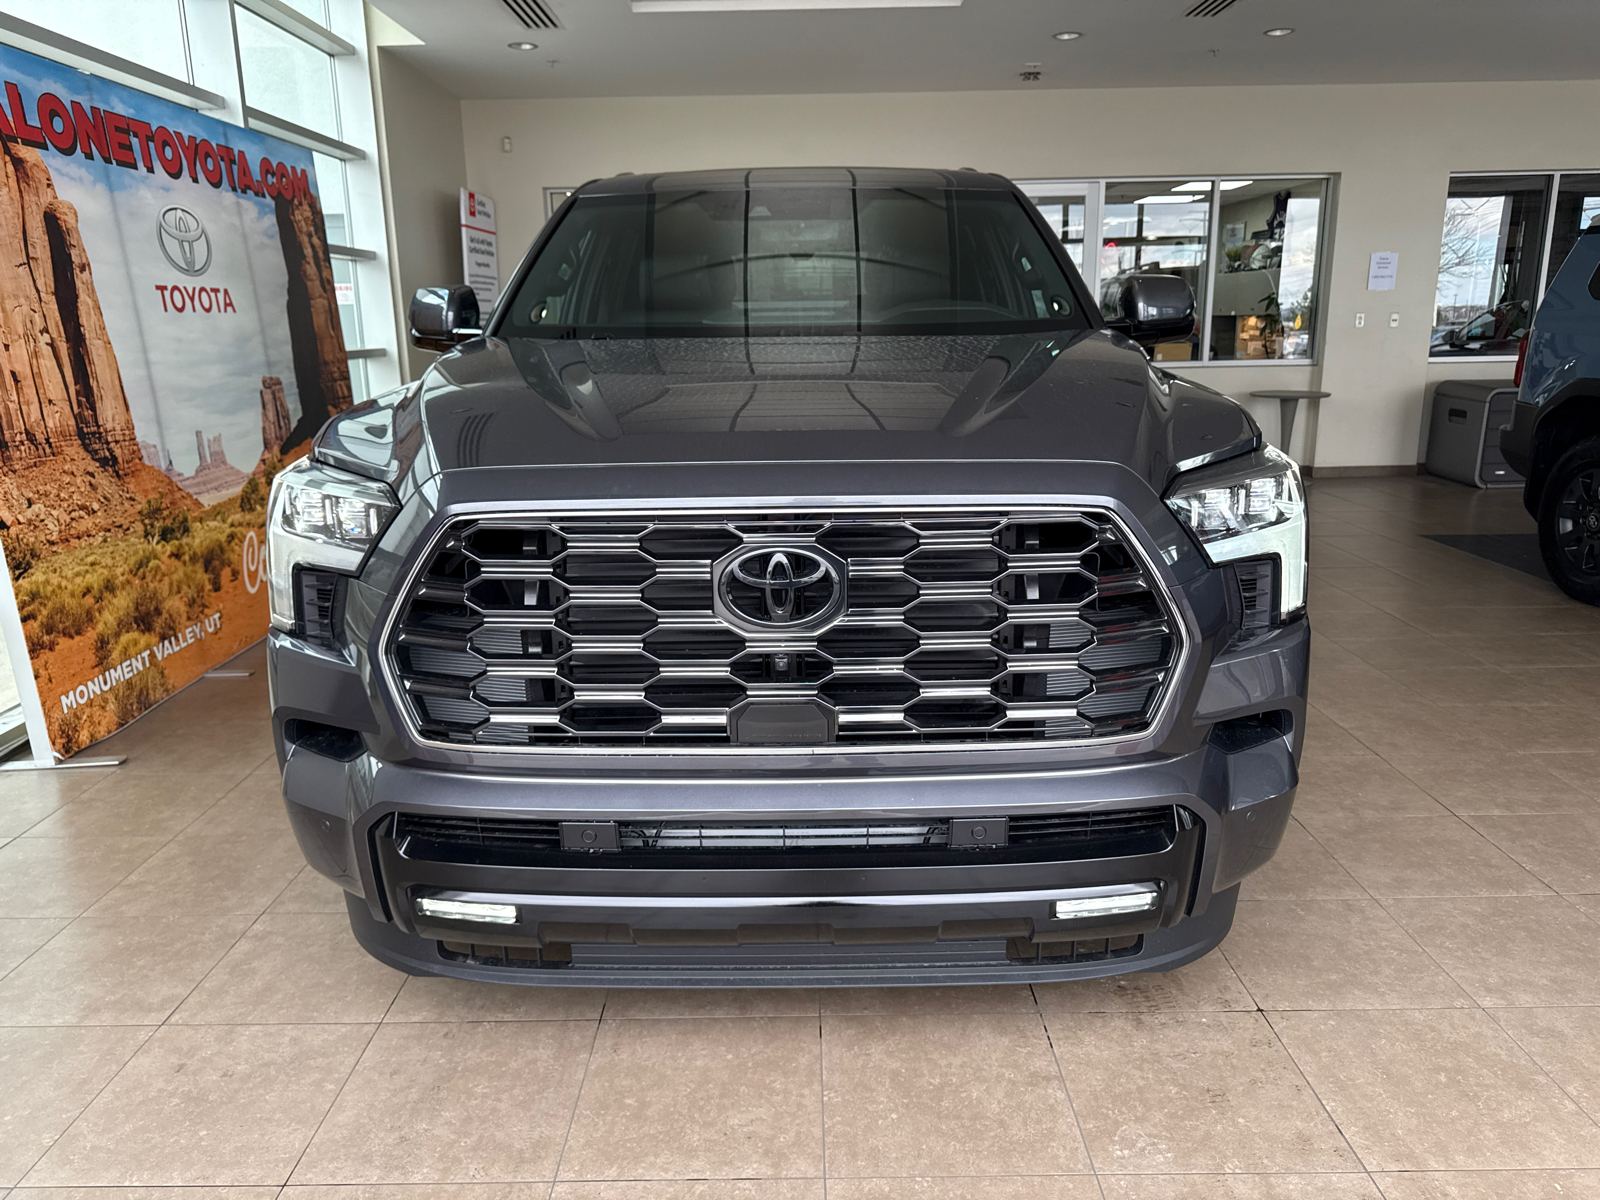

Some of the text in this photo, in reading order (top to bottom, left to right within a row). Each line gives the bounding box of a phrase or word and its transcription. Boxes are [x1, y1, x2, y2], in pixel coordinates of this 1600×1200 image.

[154, 284, 237, 314] TOYOTA
[60, 612, 222, 715] MONUMENT VALLEY, UT
